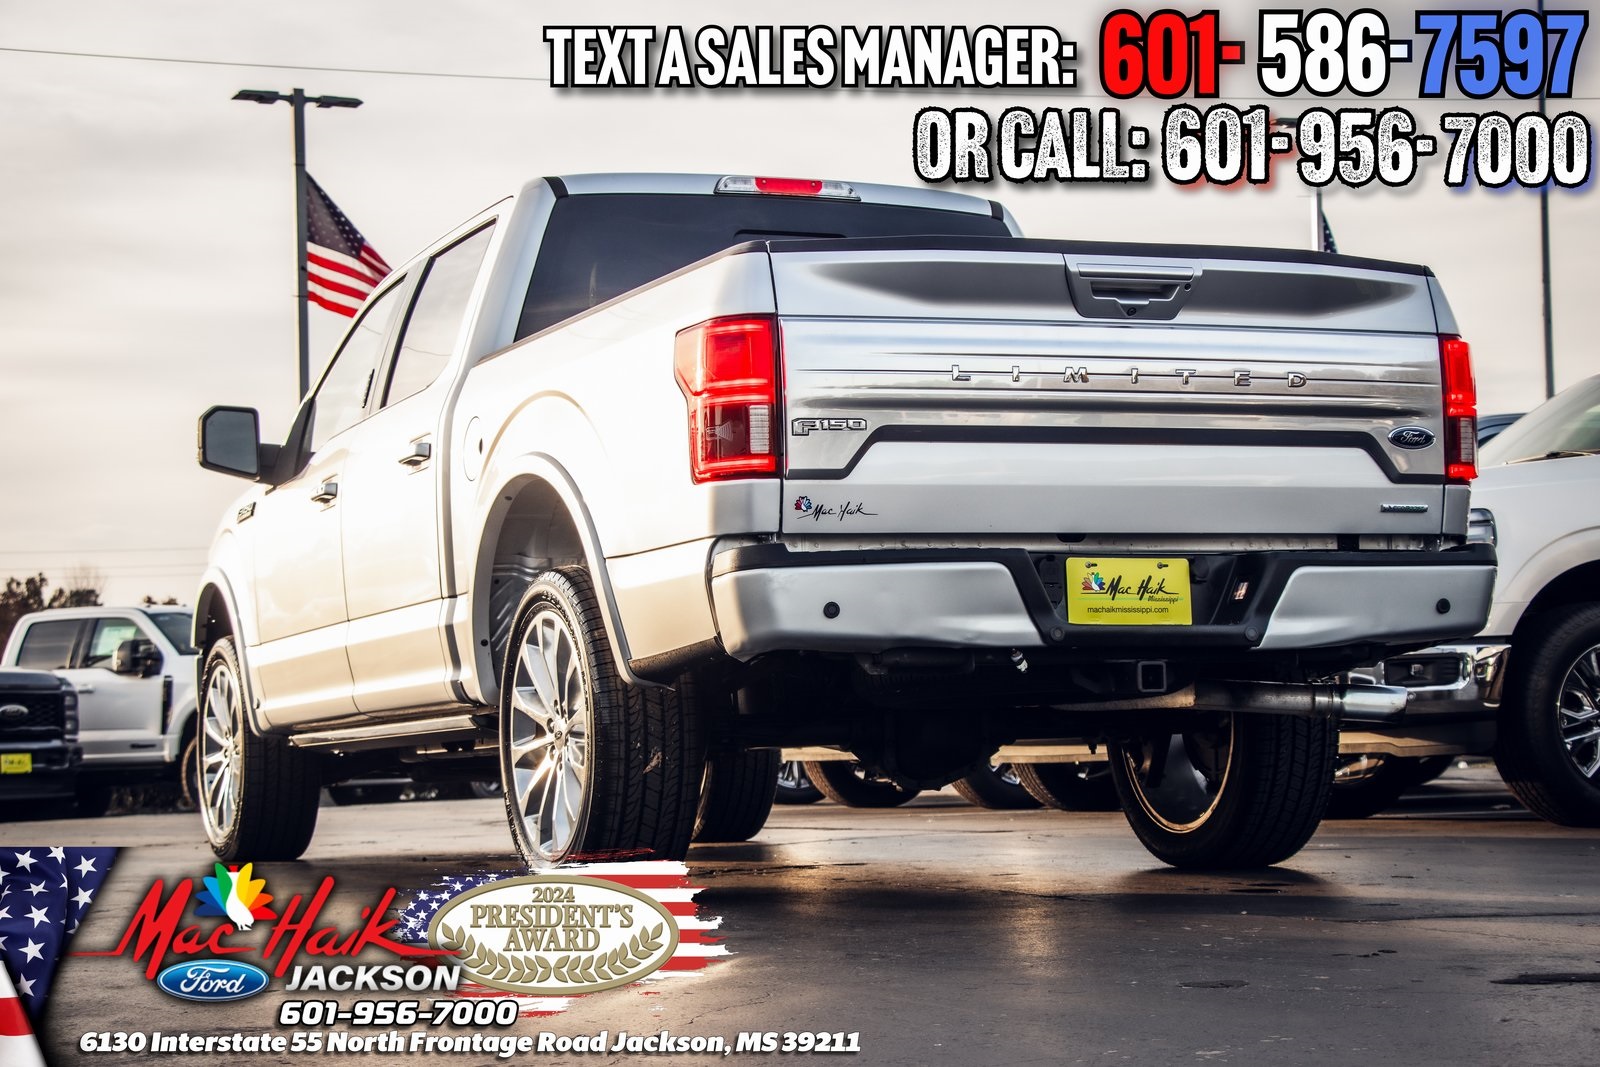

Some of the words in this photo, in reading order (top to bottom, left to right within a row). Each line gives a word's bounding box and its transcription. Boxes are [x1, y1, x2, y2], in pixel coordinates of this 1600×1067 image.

[952, 365, 1307, 388] LIMITED
[804, 504, 836, 521] Mac
[838, 501, 878, 521] Haik
[1097, 575, 1134, 601] Mac
[1137, 575, 1179, 601] Haik
[1148, 595, 1179, 605] Mississippi
[1087, 606, 1169, 615] machaikmississippi.com
